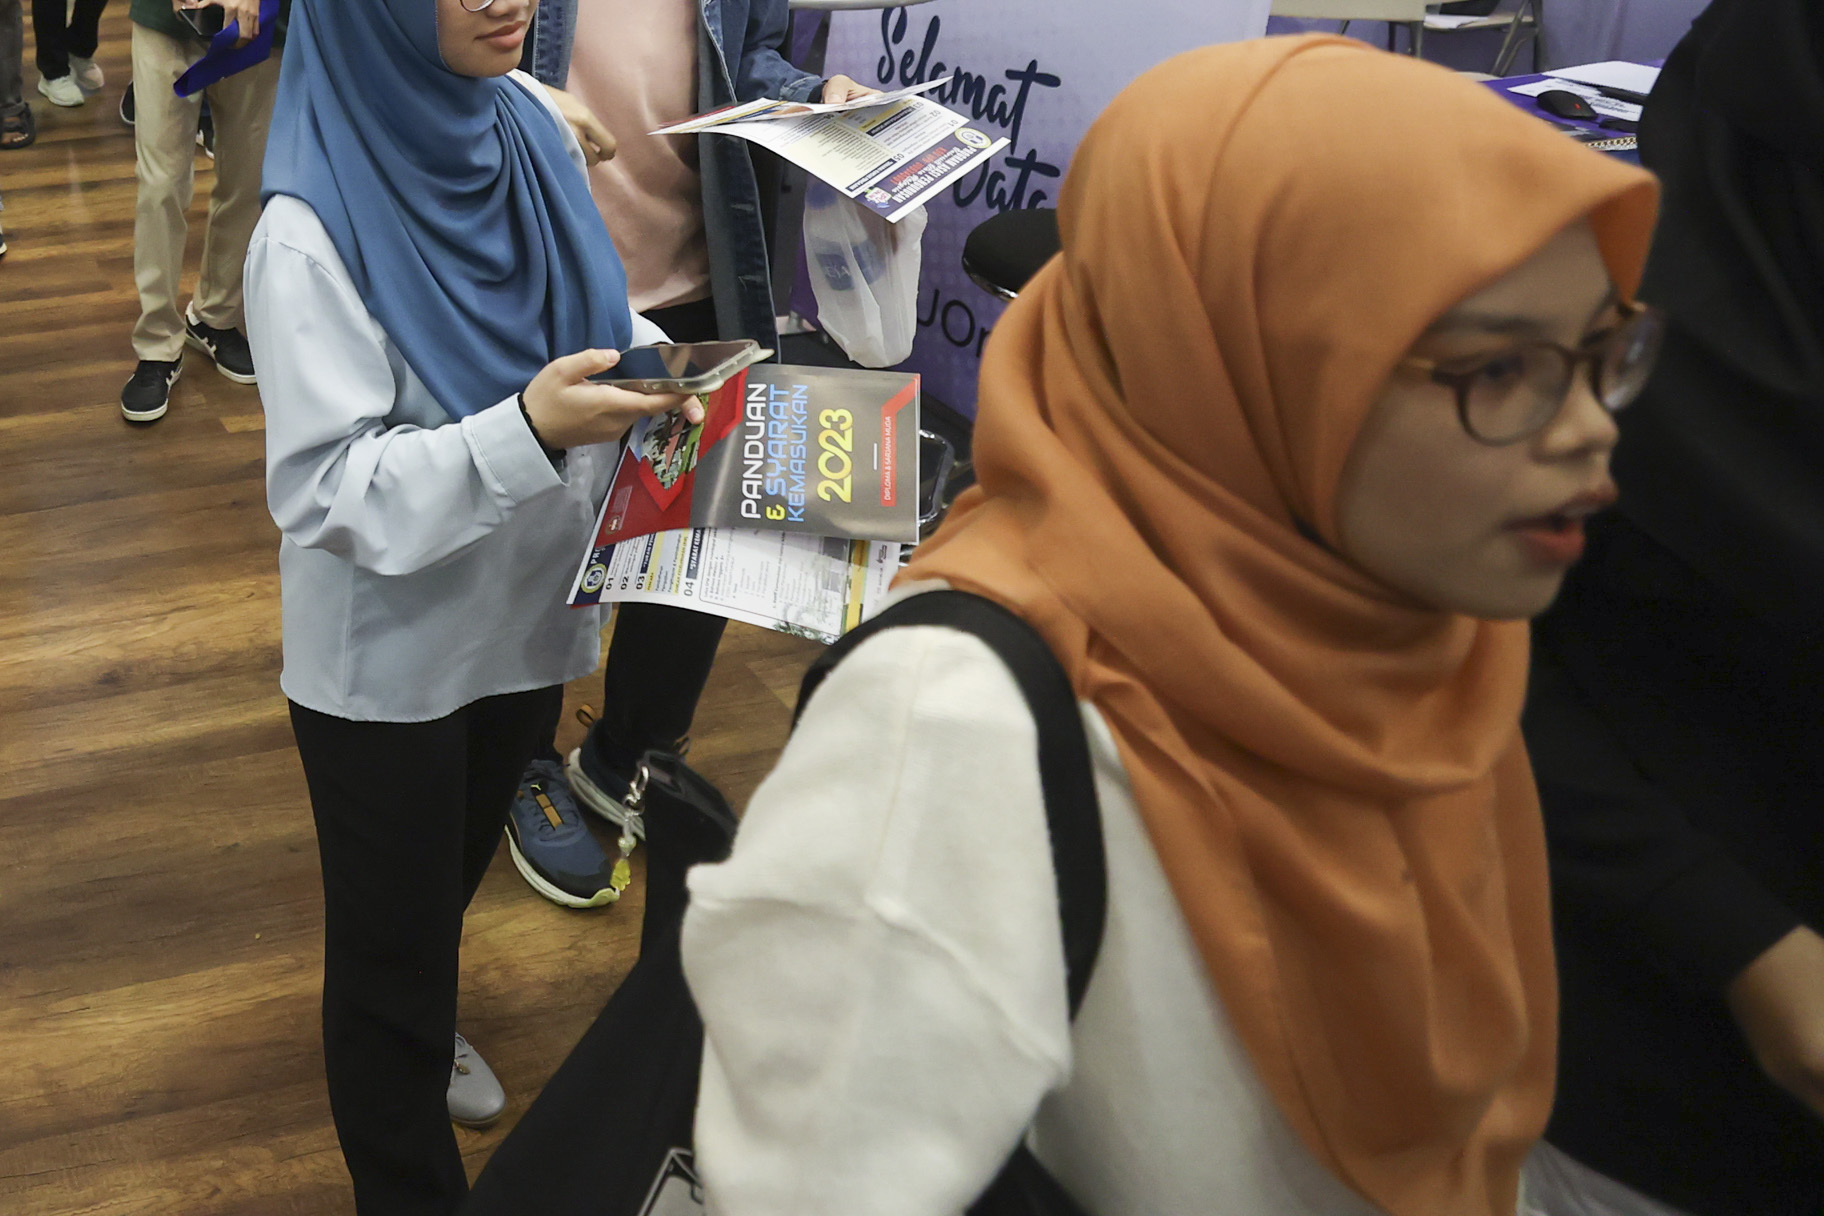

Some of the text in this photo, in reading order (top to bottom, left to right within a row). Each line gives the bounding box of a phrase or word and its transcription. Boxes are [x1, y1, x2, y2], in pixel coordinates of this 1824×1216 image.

[877, 6, 1061, 155] Selamat
[740, 383, 767, 519] PANDUAN
[766, 384, 790, 496] SYARAT
[787, 384, 808, 522] KEMASUKAN
[817, 408, 854, 503] 2023
[606, 577, 614, 590] 01
[620, 576, 629, 590] 02
[635, 575, 645, 590] 03
[684, 581, 694, 596] 04
